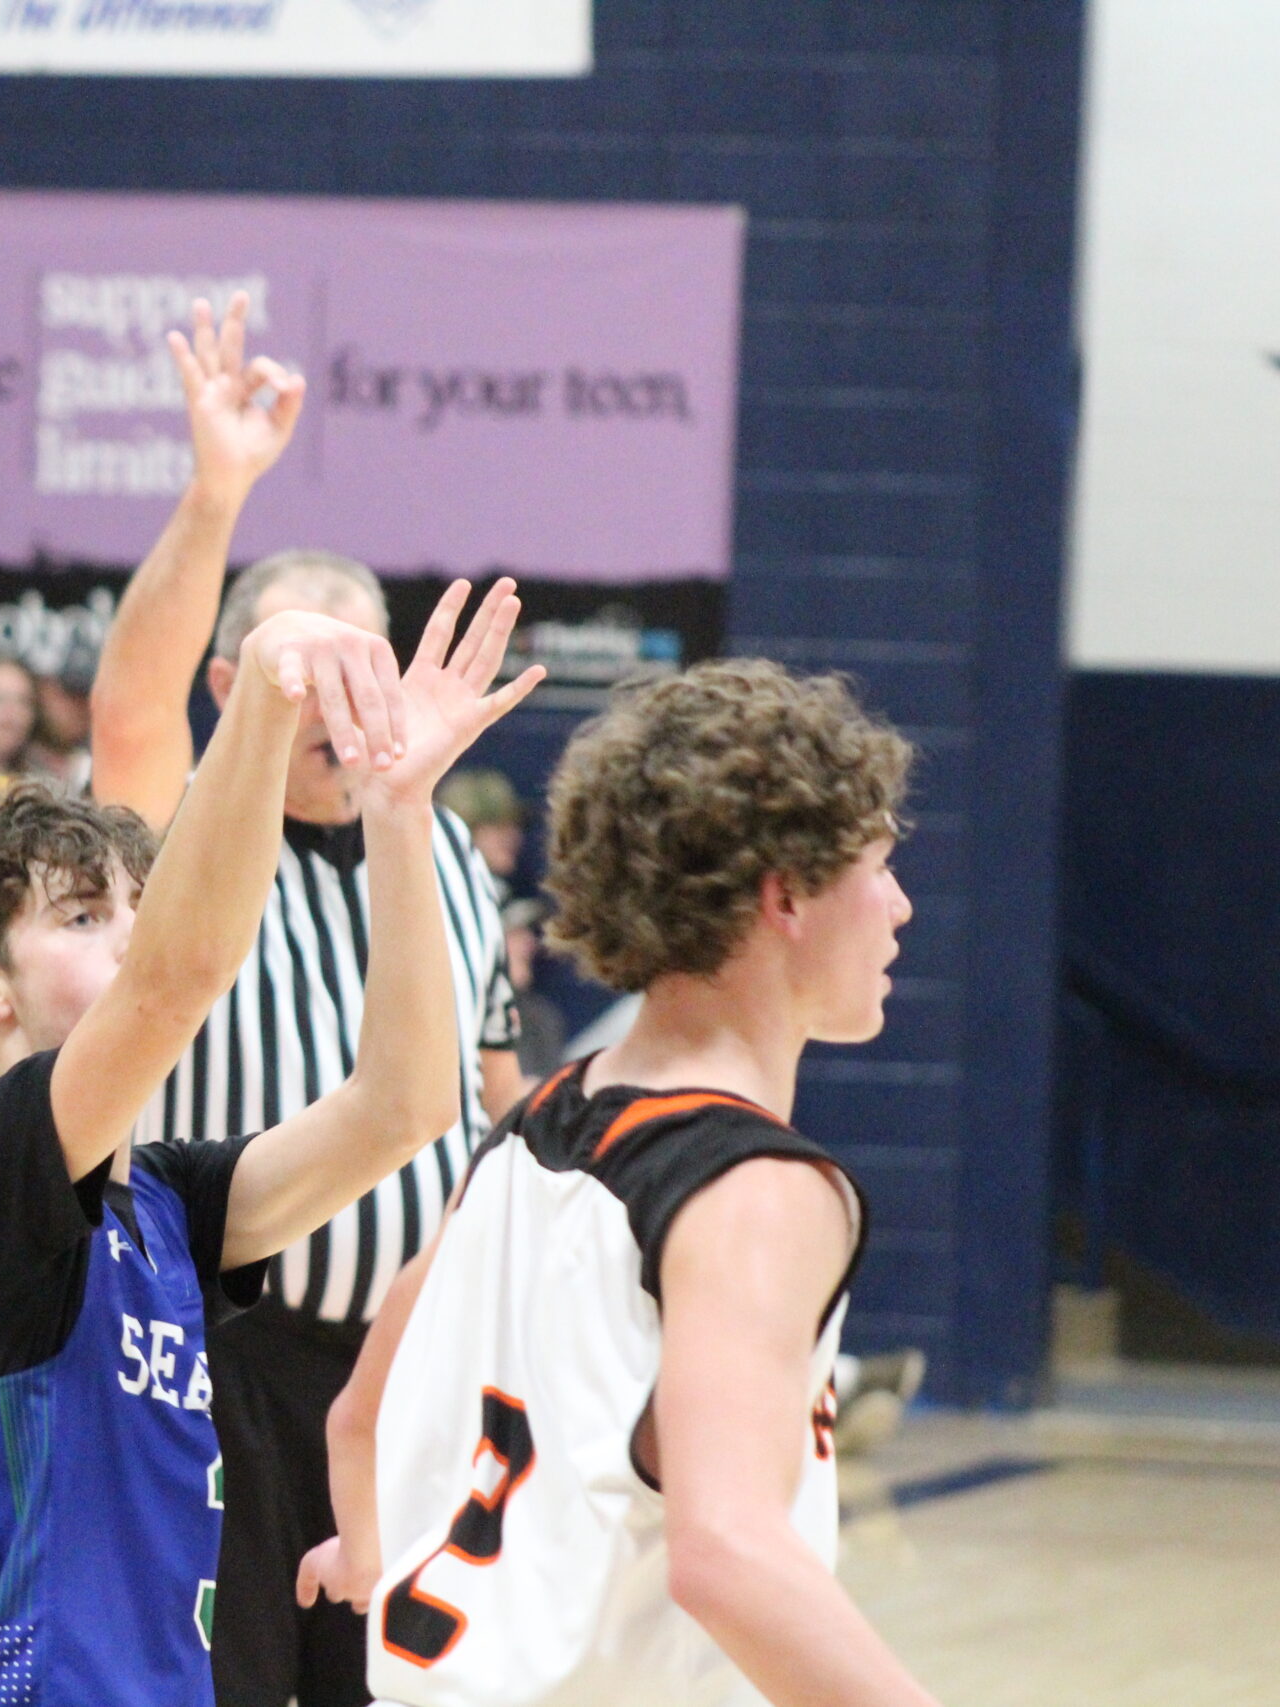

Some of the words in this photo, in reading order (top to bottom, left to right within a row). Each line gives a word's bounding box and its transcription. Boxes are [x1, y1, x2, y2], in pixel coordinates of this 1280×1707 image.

[328, 344, 400, 410] for
[417, 367, 547, 435] your
[381, 1384, 537, 1670] 2
